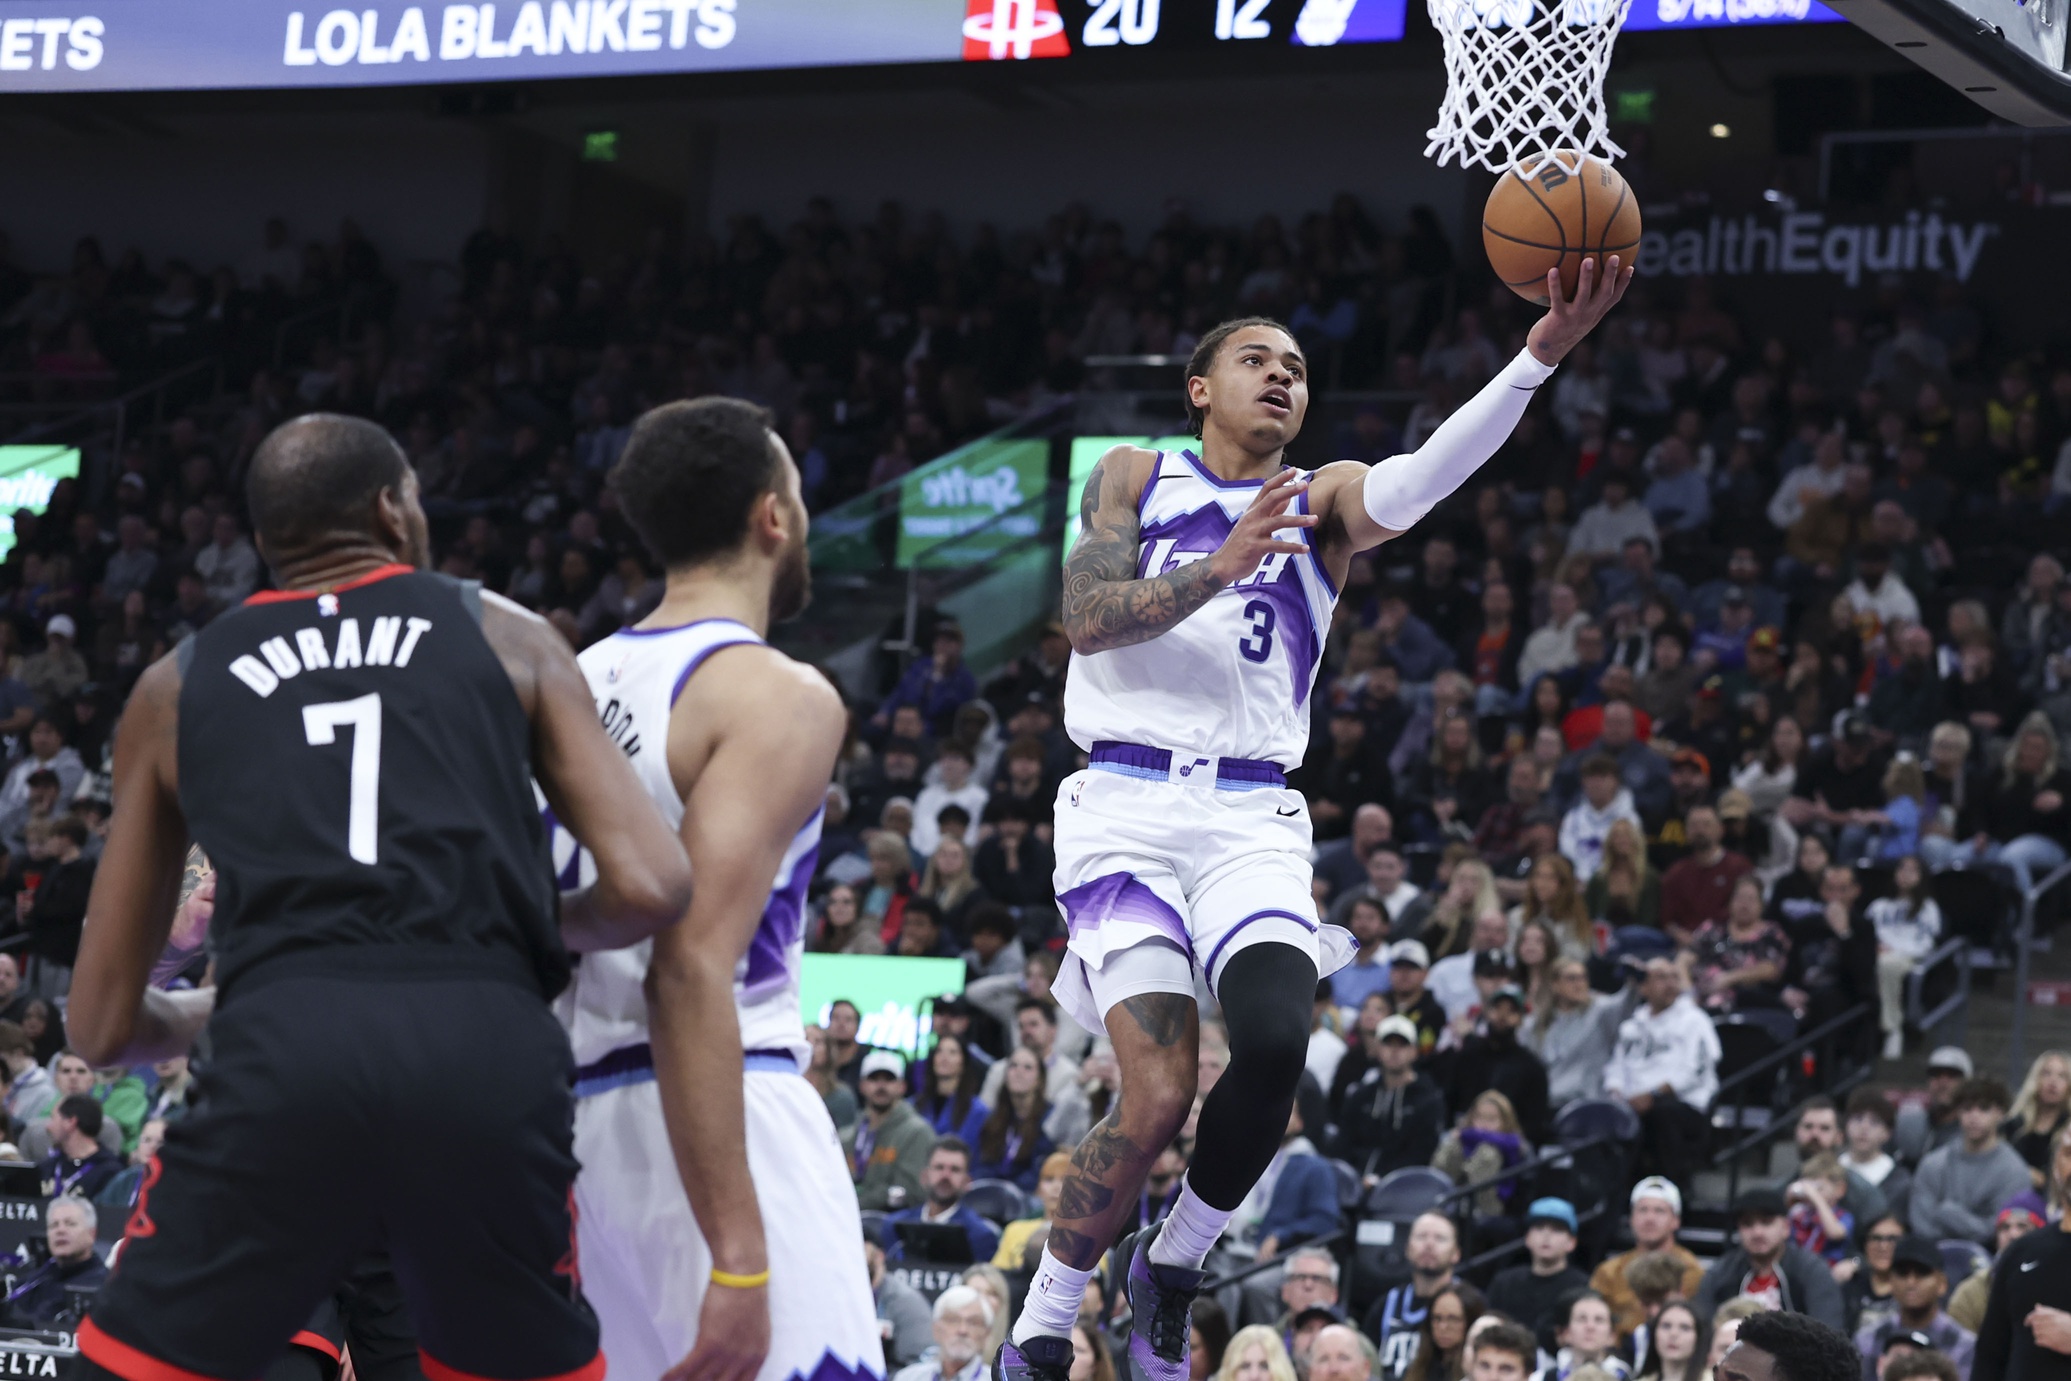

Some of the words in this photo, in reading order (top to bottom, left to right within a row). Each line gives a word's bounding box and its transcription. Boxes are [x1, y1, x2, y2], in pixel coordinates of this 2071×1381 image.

[283, 7, 431, 66] LOLA
[439, 0, 738, 61] BLANKETS
[1082, 0, 1161, 46] 20
[1215, 0, 1271, 40] 12
[1640, 211, 1987, 286] ealthEquity
[228, 616, 433, 698] DURANT
[1239, 599, 1275, 664] 3
[302, 692, 381, 865] 7
